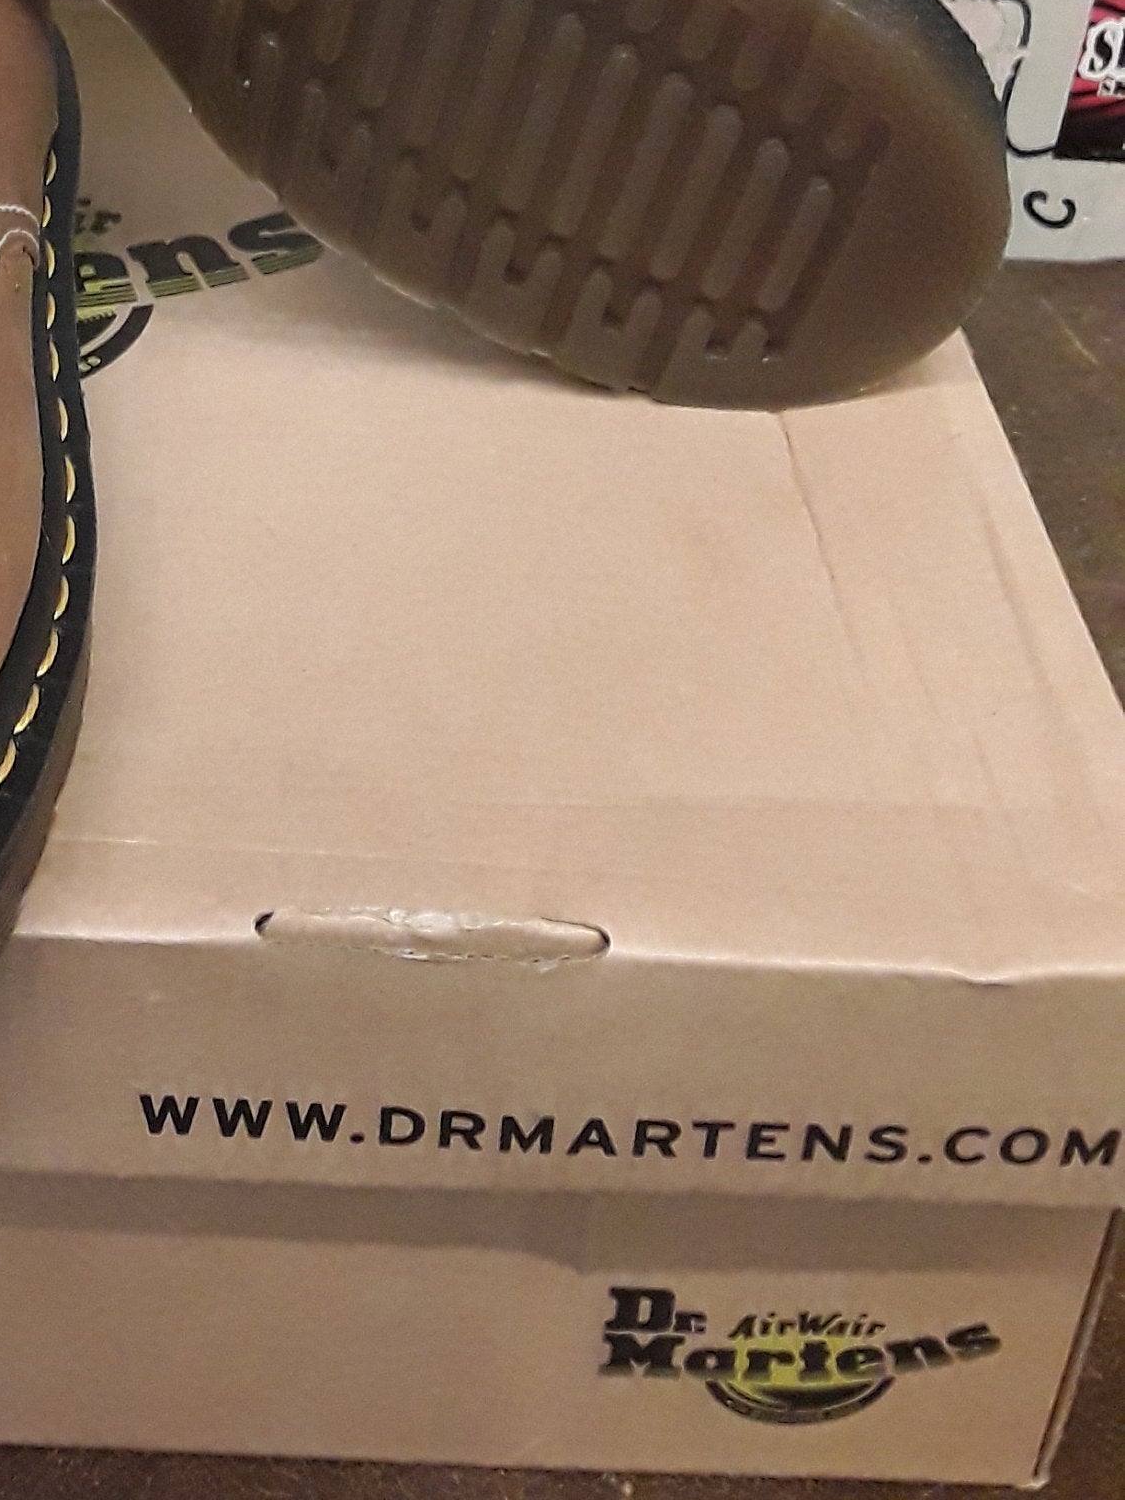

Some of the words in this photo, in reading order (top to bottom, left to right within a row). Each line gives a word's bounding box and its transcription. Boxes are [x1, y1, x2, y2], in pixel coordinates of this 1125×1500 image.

[139, 1094, 1122, 1168] WWW.DRMARTENS.COM
[604, 1285, 708, 1334] Dr.
[728, 1310, 887, 1339] AirWair
[598, 1322, 1003, 1381] Martens
